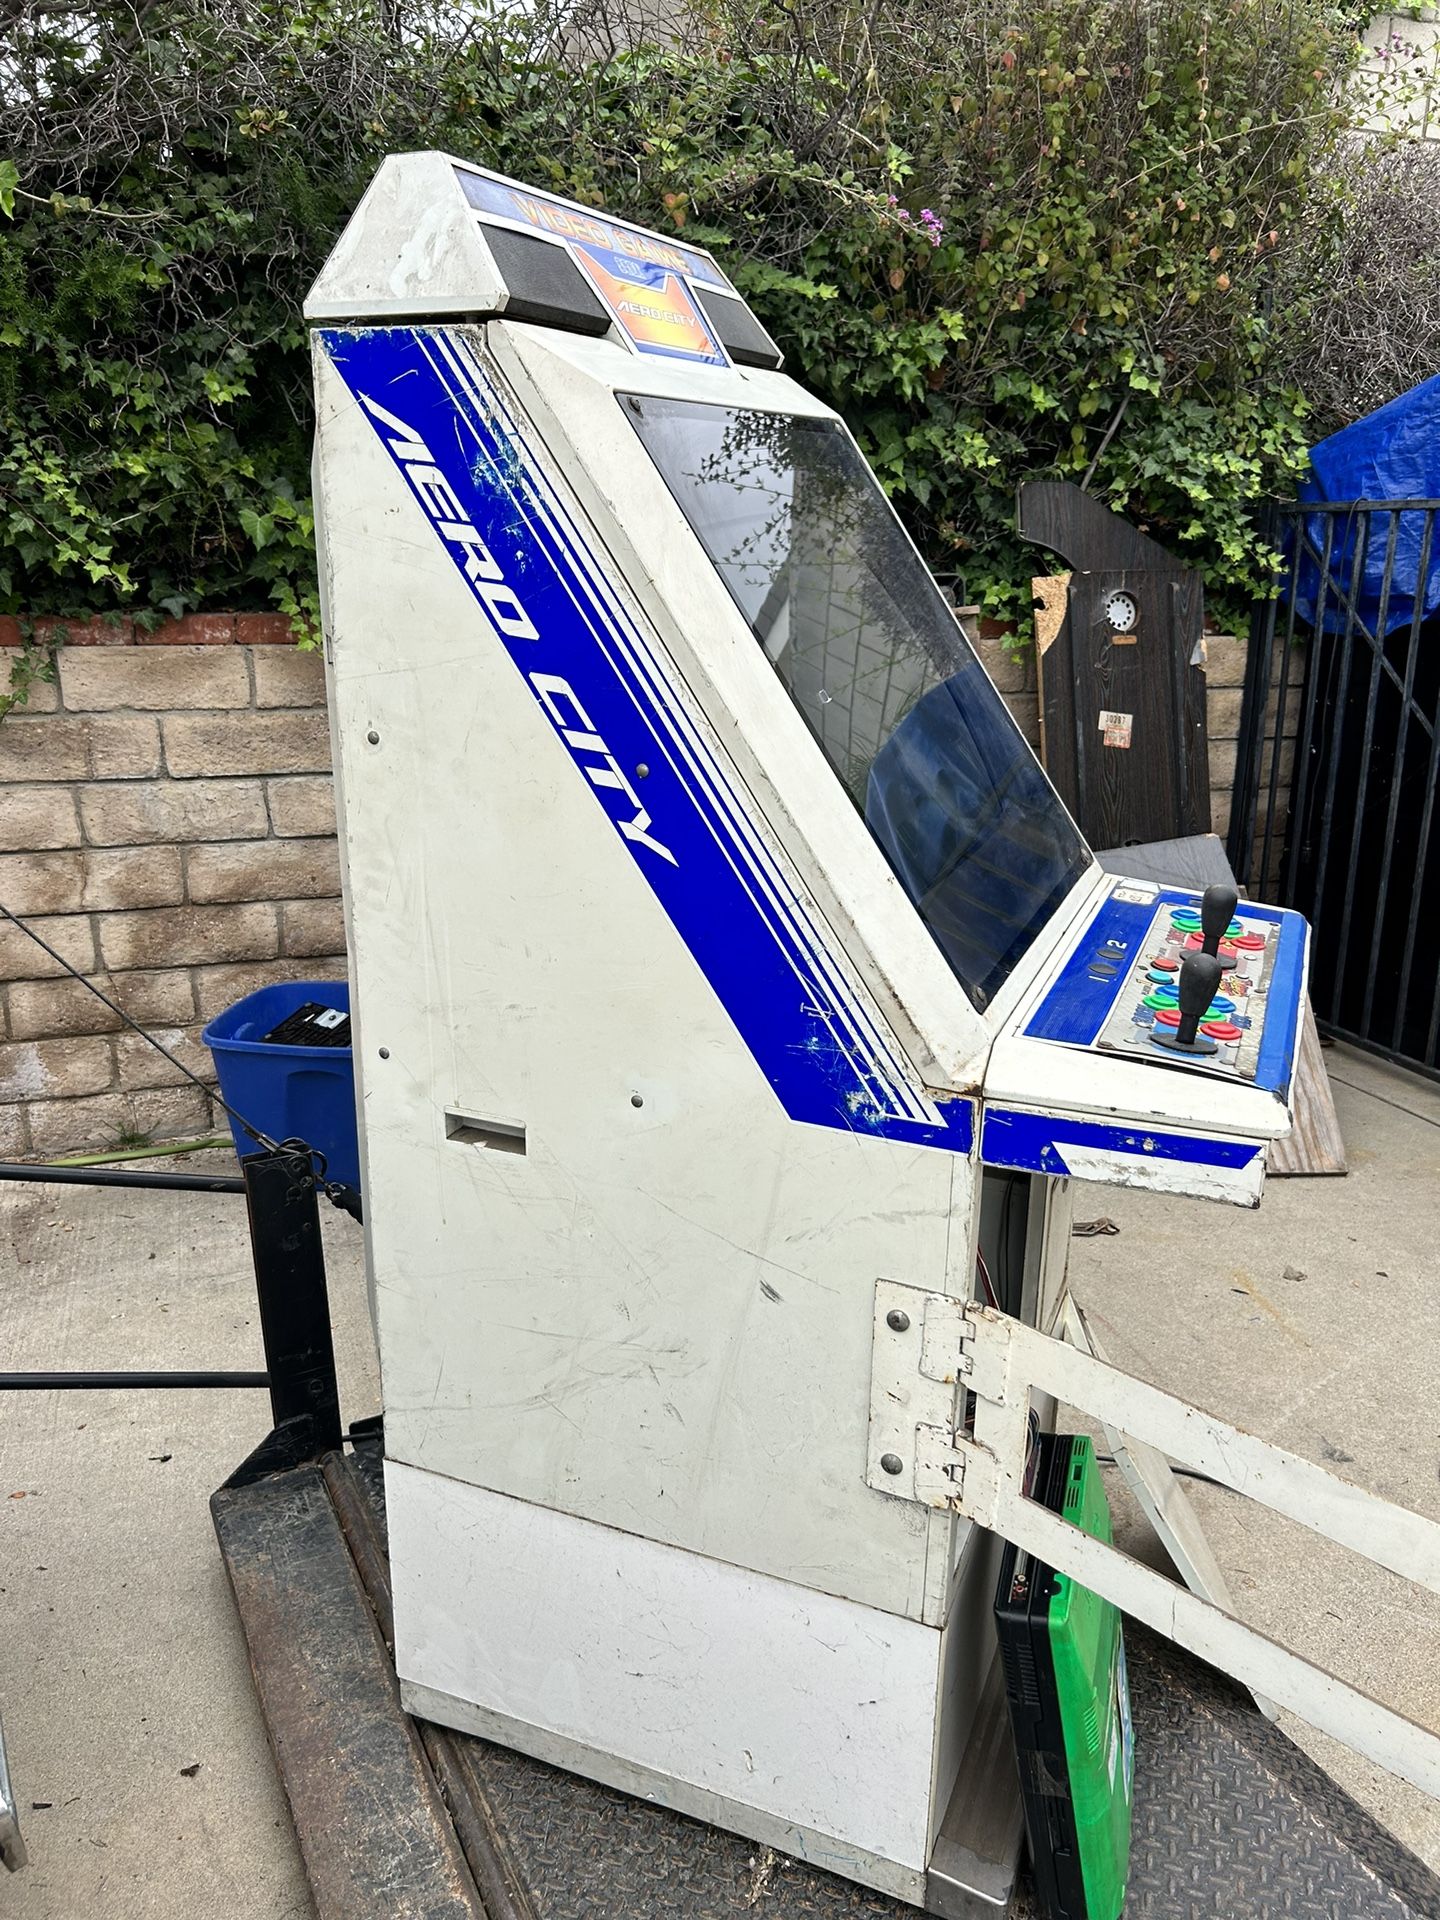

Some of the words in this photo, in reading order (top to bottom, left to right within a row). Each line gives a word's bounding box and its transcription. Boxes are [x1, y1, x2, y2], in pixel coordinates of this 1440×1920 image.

[508, 191, 613, 250] VIDEO
[611, 228, 693, 276] GAME
[616, 300, 663, 321] AERO
[662, 310, 697, 328] CITY
[357, 389, 540, 642] AERO
[528, 670, 680, 868] CITY
[1106, 939, 1127, 950] 2
